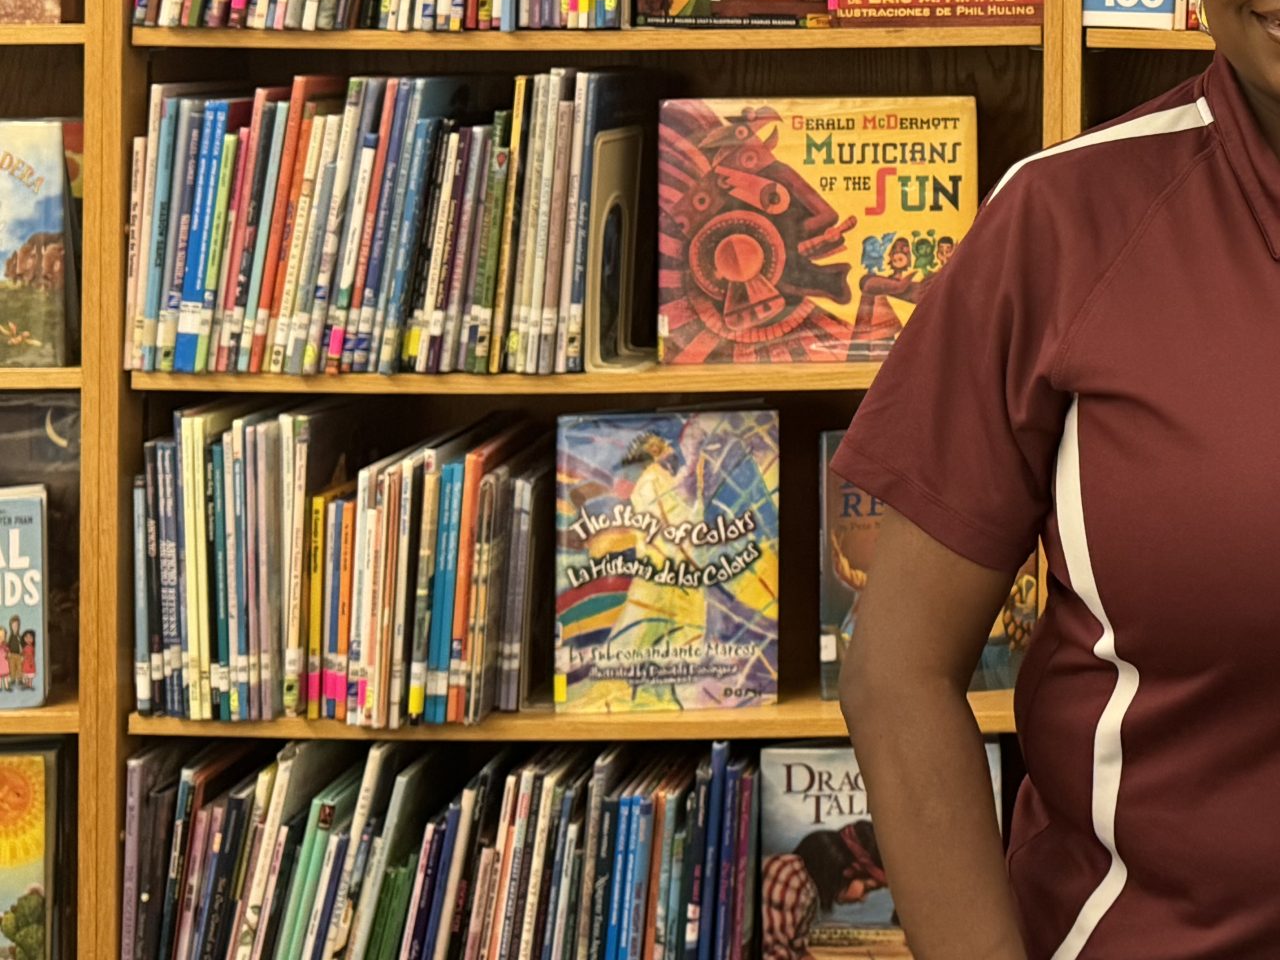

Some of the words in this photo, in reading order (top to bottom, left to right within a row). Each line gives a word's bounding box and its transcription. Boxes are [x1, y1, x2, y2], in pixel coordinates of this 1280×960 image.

[935, 7, 952, 17] DE
[955, 5, 984, 17] PHIL
[987, 4, 1035, 16] HULING
[791, 115, 856, 132] GERALD
[802, 133, 963, 166] MUSICIANS
[819, 177, 837, 191] OF
[843, 176, 872, 191] THE
[864, 167, 963, 217] SUN
[568, 506, 610, 540] The
[663, 522, 691, 545] of
[691, 511, 756, 546] Colors
[567, 567, 590, 588] La
[589, 553, 653, 581] Historia
[654, 559, 676, 584] de
[678, 561, 701, 587] los
[702, 543, 759, 586] Colores
